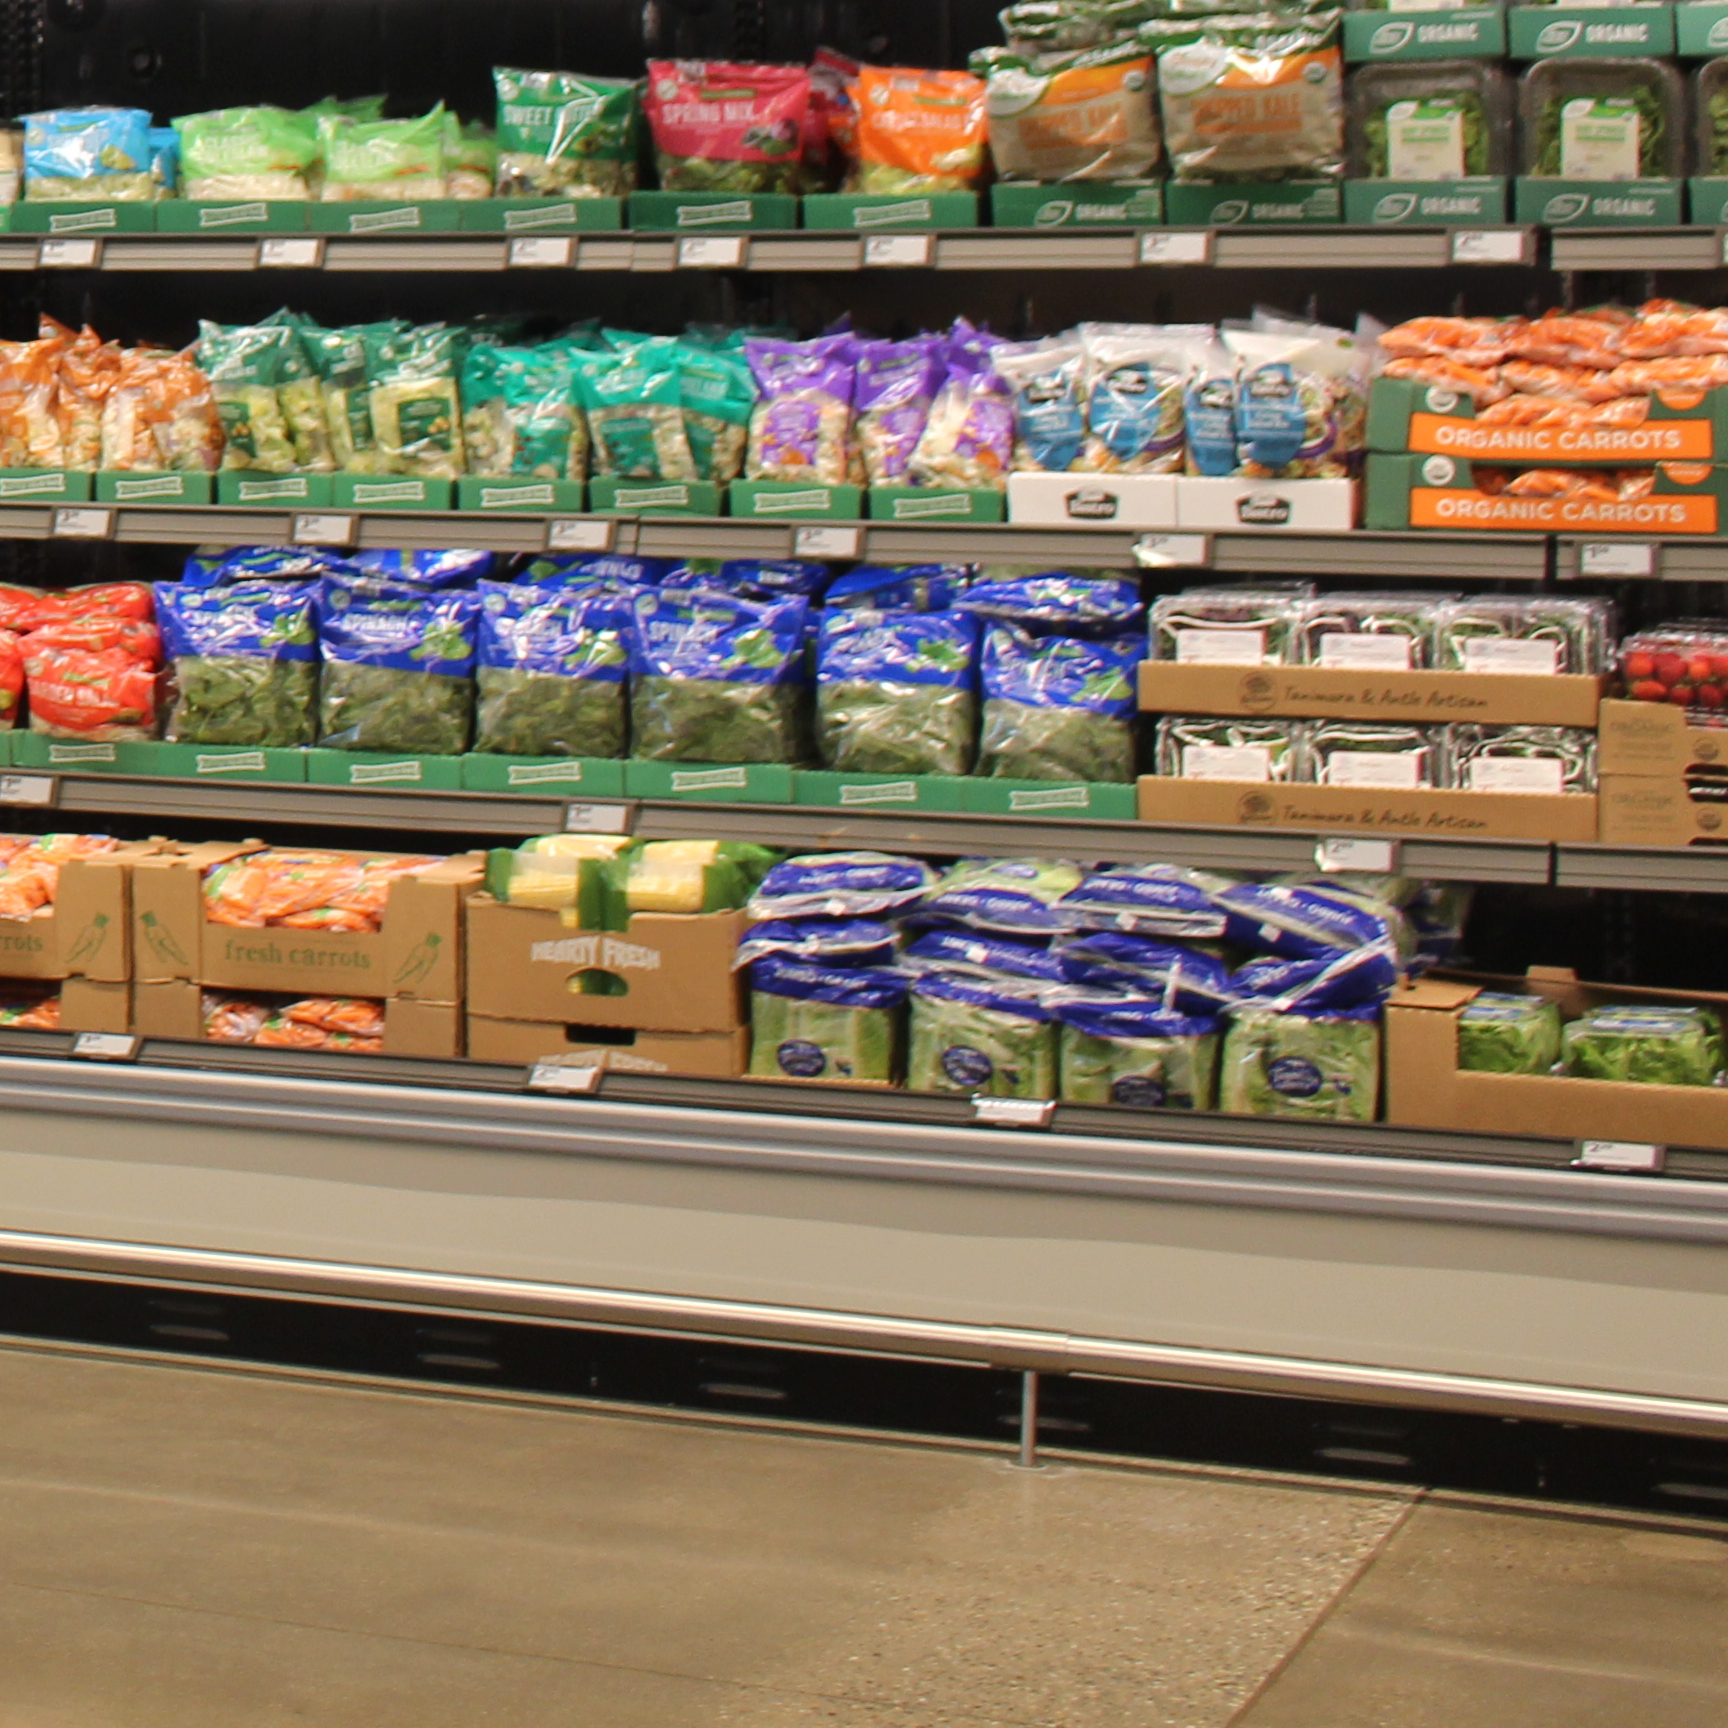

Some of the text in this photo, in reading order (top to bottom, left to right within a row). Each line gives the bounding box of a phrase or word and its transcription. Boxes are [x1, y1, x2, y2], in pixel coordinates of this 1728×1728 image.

[1435, 426, 1682, 451] ORGANIC CARROTS
[1436, 498, 1686, 523] ORGANIC CARROTS
[225, 938, 372, 970] fresh carrots
